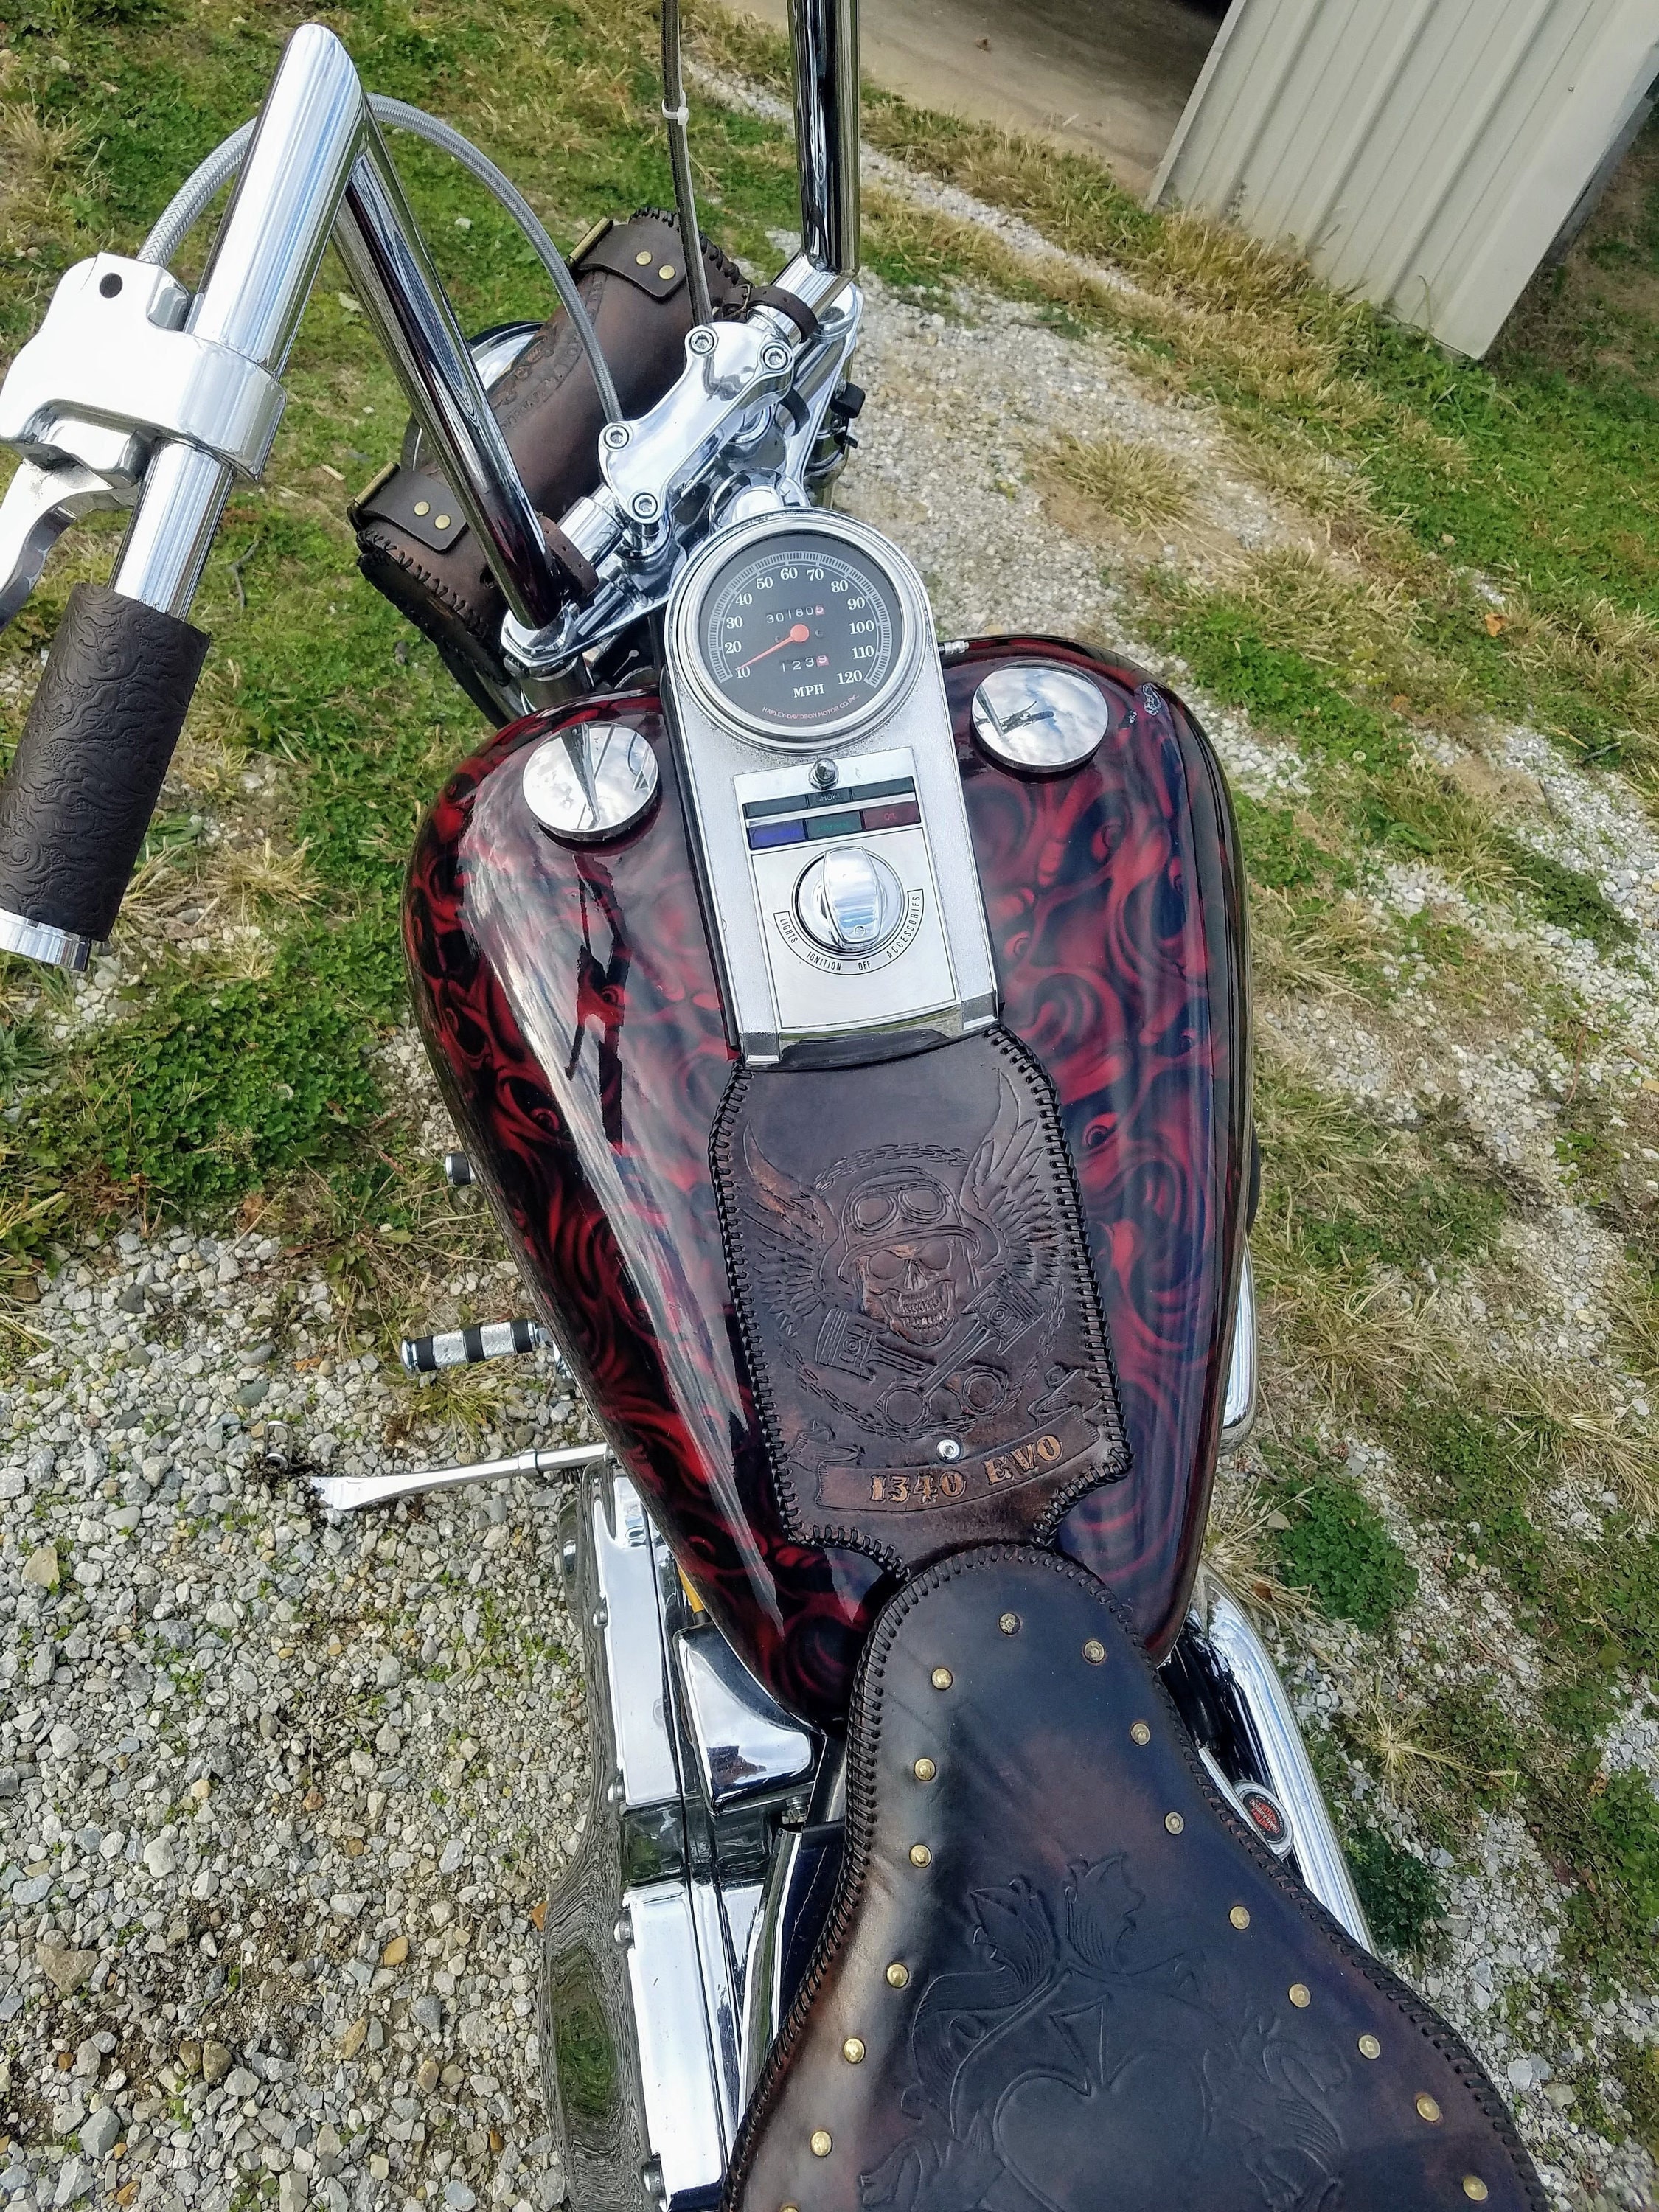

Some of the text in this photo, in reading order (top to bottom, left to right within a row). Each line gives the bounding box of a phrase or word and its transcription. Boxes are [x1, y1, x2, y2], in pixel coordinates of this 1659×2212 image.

[780, 568, 798, 580] 60
[806, 568, 824, 581] 70
[757, 576, 773, 589] 50
[831, 580, 849, 592] 80
[735, 593, 753, 606] 40
[847, 597, 866, 610] 90
[726, 616, 743, 629] 30
[849, 619, 874, 635] 100
[724, 641, 742, 654] 20
[852, 645, 874, 659] 110
[736, 666, 751, 678] 10
[836, 669, 863, 685] 120
[793, 684, 825, 698] MPH
[762, 706, 818, 720] HARLEY-DAVIDSON
[818, 706, 839, 717] MOTOR
[779, 917, 798, 944] LIGHTS
[886, 895, 921, 959] ACCESSORIES
[806, 951, 842, 971] IGNITION
[858, 960, 872, 971] OFF
[870, 1435, 1063, 1504] 1340 EVO
